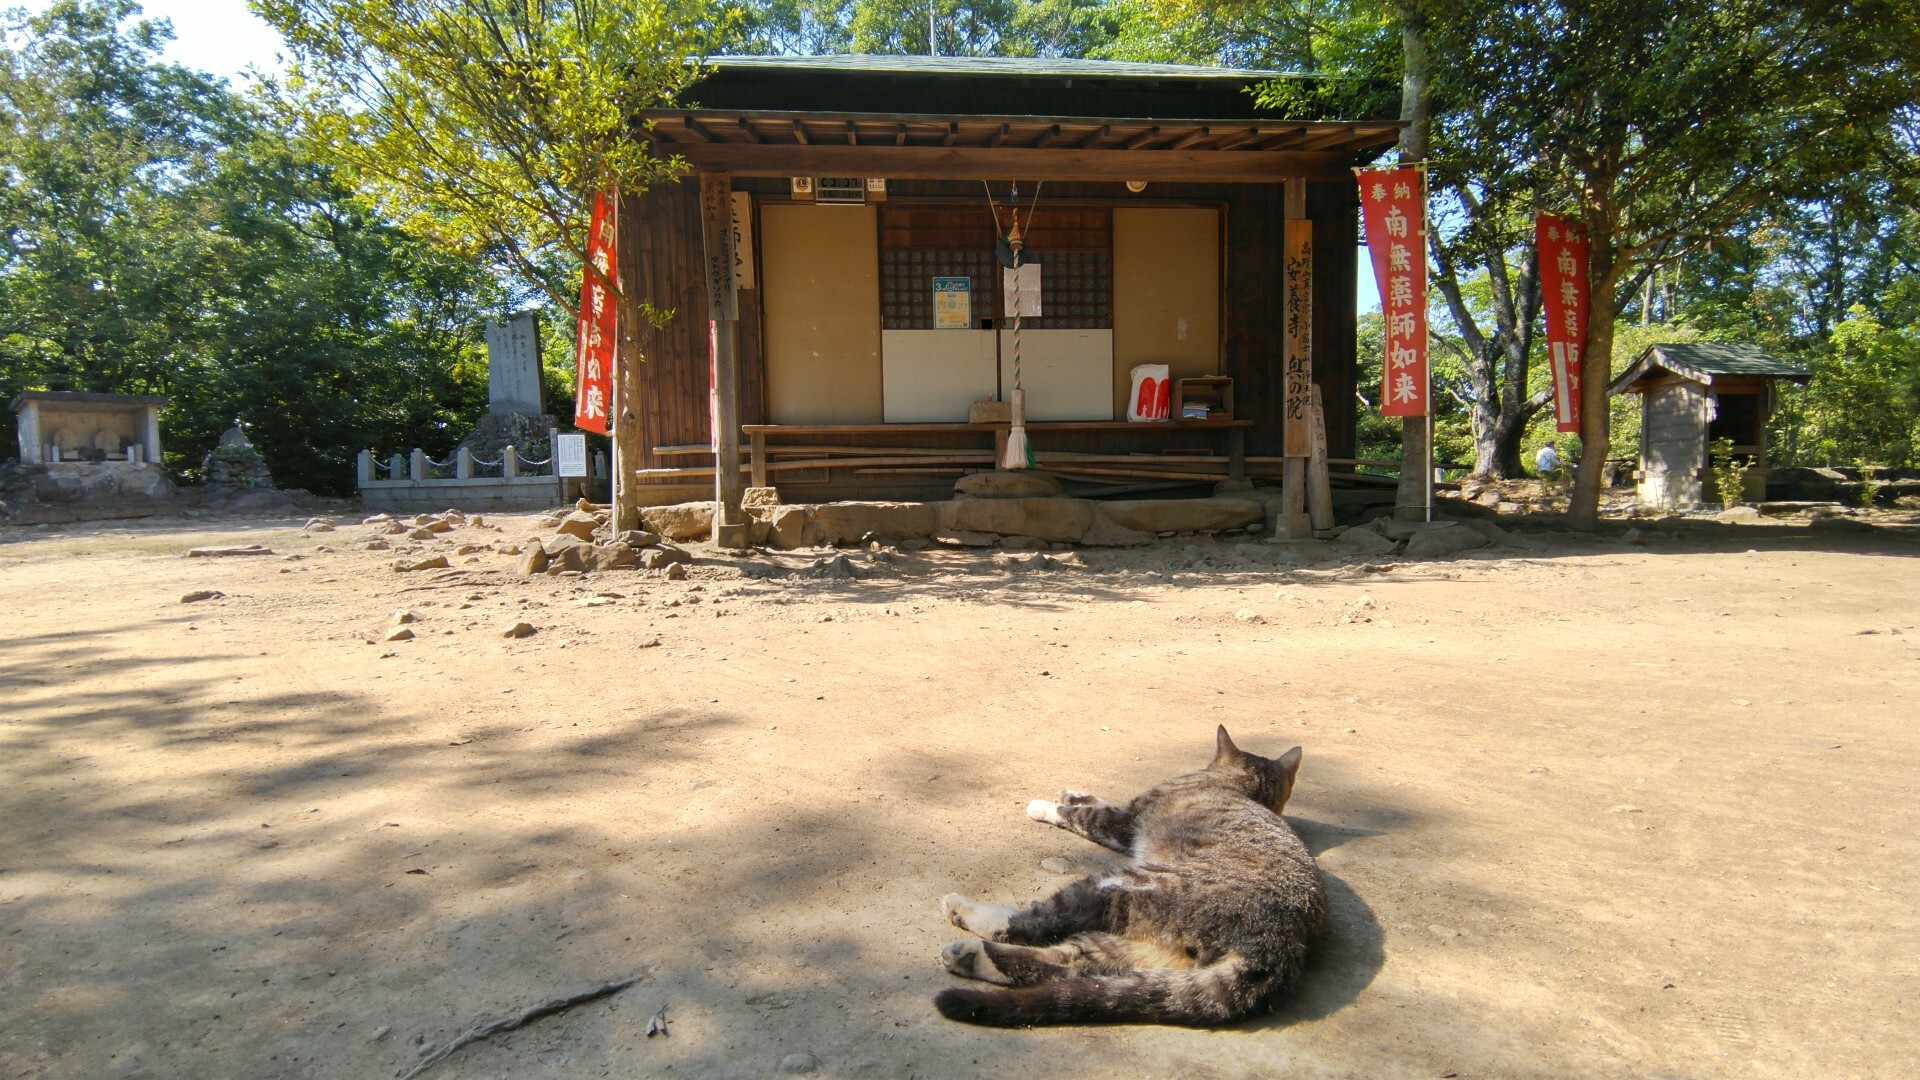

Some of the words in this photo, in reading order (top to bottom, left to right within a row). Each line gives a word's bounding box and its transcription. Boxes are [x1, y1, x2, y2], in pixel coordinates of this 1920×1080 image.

[1371, 182, 1411, 202] 奉納
[1384, 204, 1419, 405] 南無薬師如来
